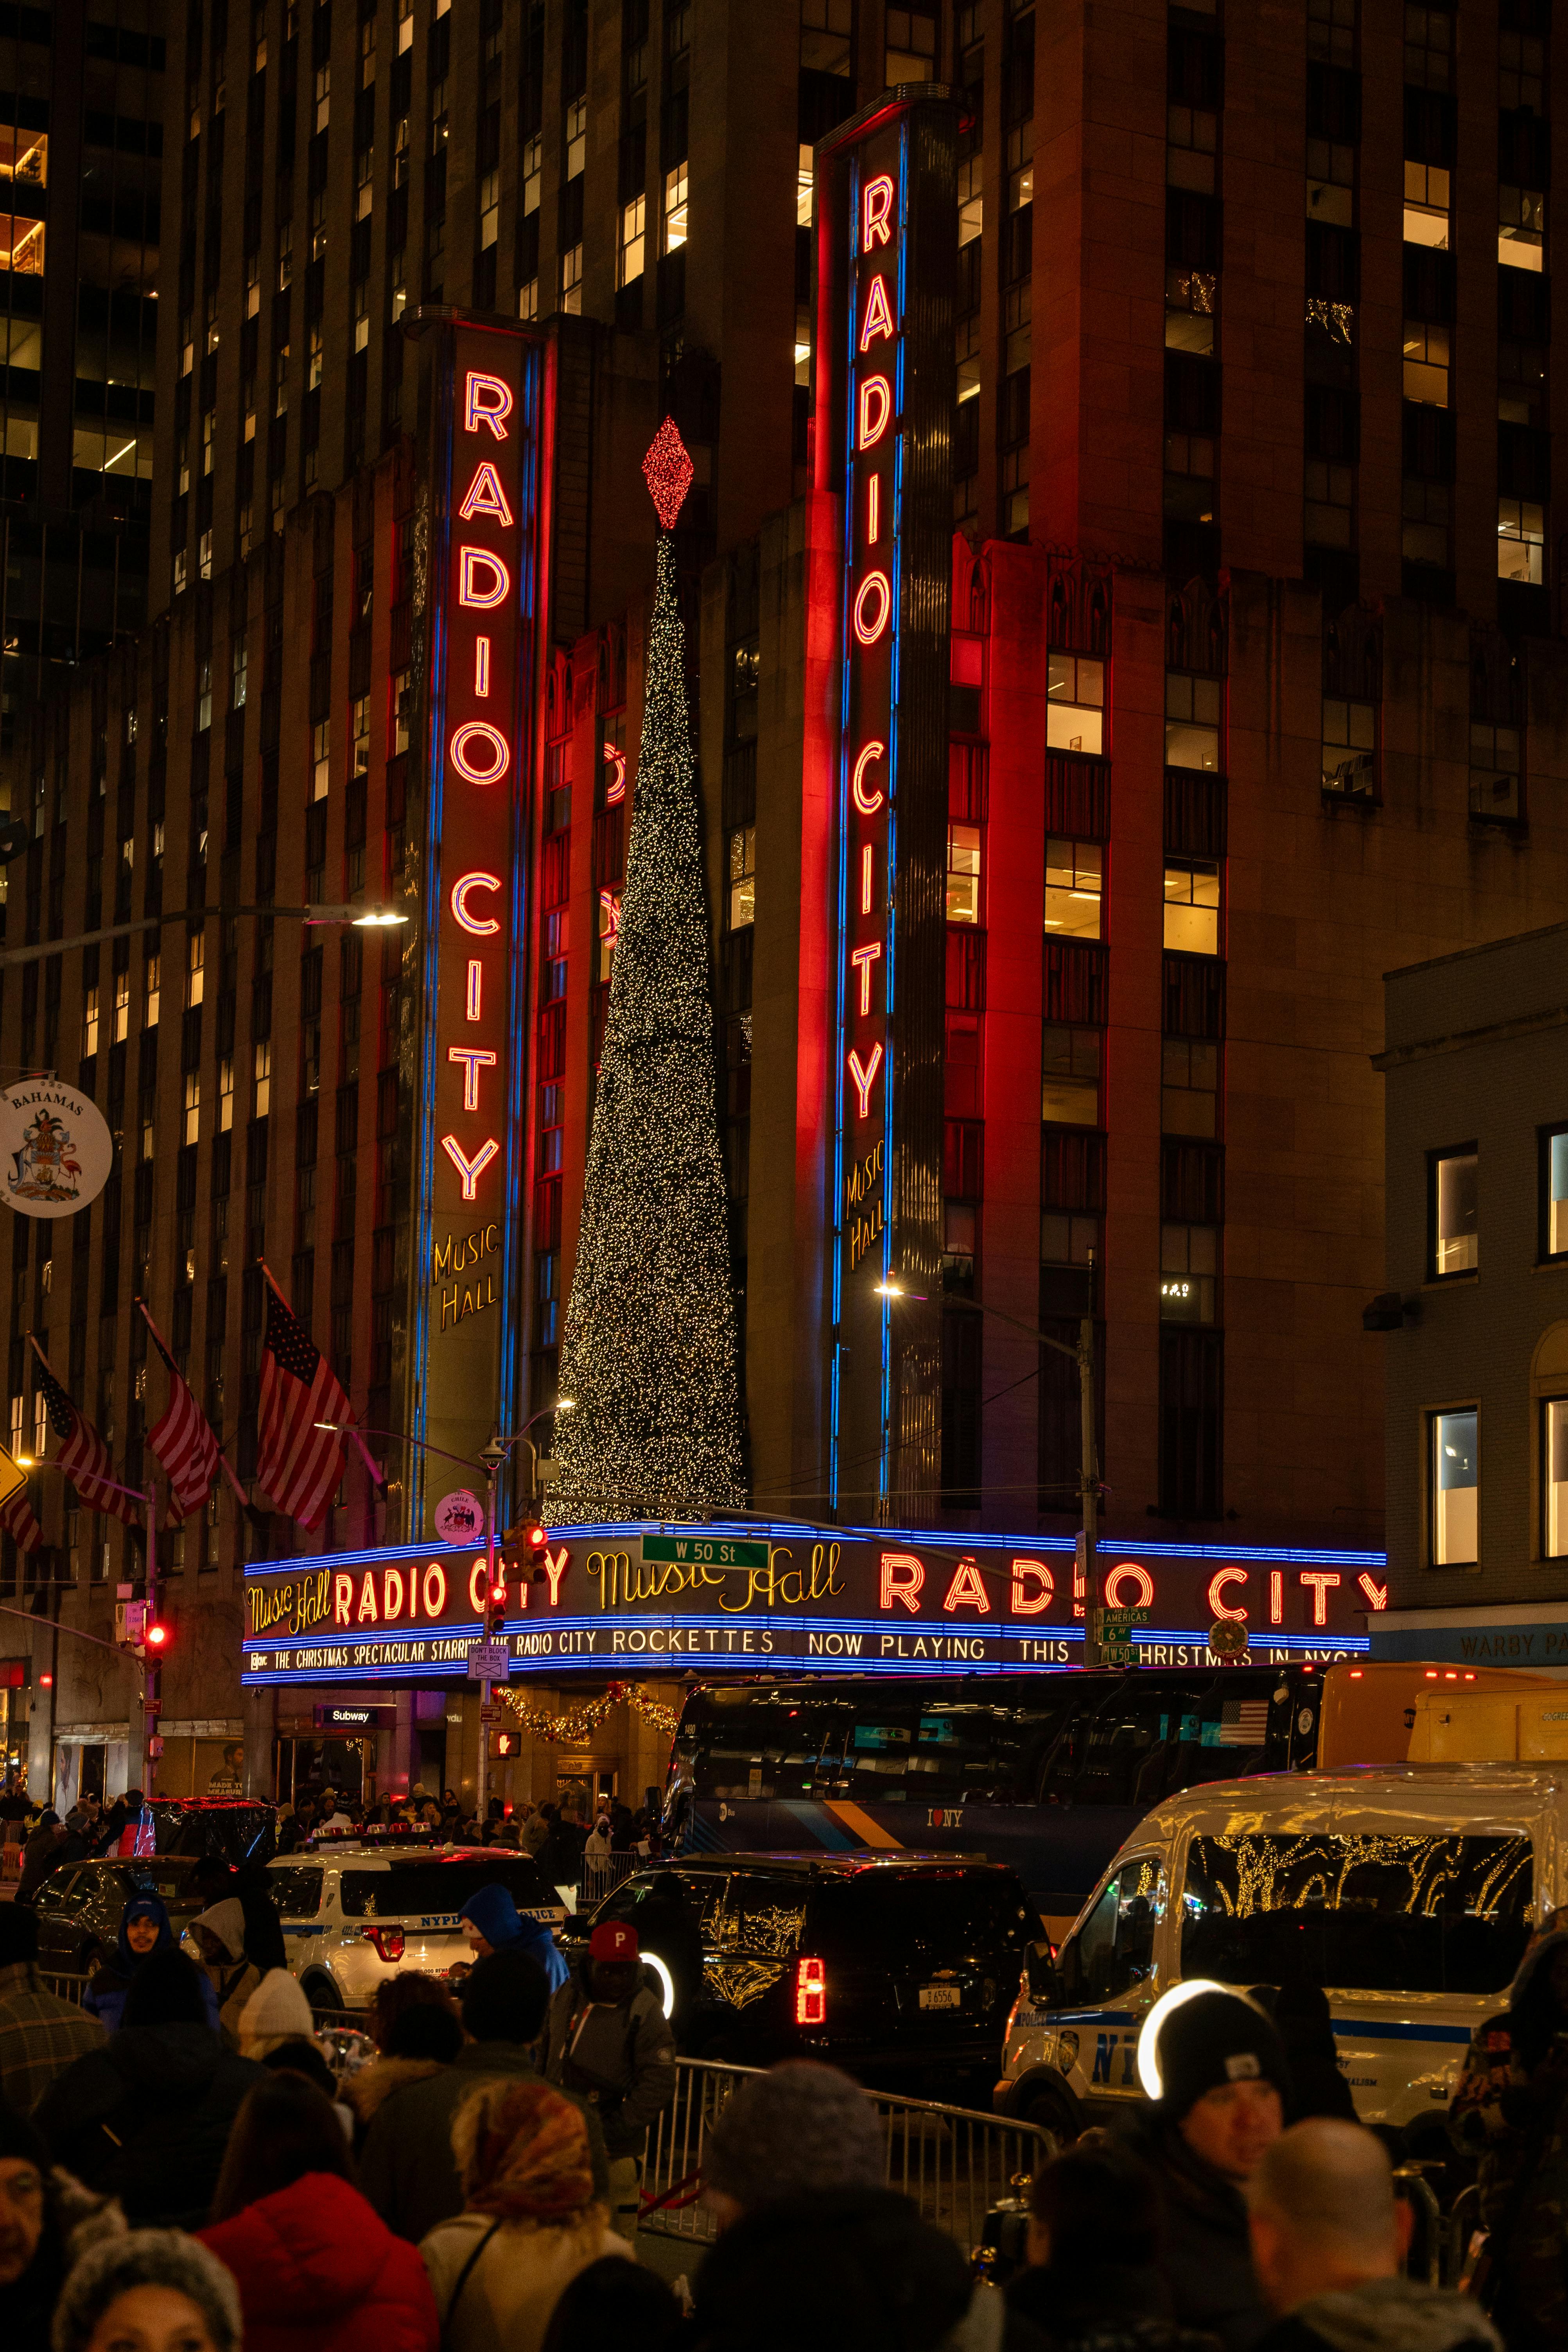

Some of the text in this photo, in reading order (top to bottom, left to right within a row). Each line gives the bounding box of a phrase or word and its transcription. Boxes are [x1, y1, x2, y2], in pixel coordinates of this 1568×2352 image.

[848, 174, 893, 1119] RADIO CITY
[441, 371, 513, 1200] RADIO CITY
[12, 1092, 83, 1116] BAHAMAS
[676, 1542, 736, 1562] W 50 St
[719, 1542, 846, 1612] Hall
[880, 1553, 1154, 1617] RADIO
[1208, 1567, 1387, 1625] CITY
[248, 1585, 292, 1633] Music
[288, 1568, 331, 1634] Hall
[335, 1562, 446, 1626] RADIO
[1106, 1612, 1148, 1623] AMERICAS
[1109, 1628, 1116, 1641] 6
[275, 1651, 290, 1669] THE
[296, 1647, 348, 1668] CHRISTMAS
[354, 1642, 425, 1665] SPECTACULAR
[431, 1638, 482, 1661] STARRI
[516, 1633, 552, 1656] RADIO
[559, 1631, 597, 1654] CITY
[613, 1629, 773, 1654] ROCKETTES
[809, 1633, 863, 1656] NOW
[881, 1635, 985, 1659] PLAYING
[1019, 1639, 1069, 1662] THIS
[1111, 1647, 1117, 1661] W
[1119, 1647, 1130, 1661] 50
[1213, 1645, 1246, 1658] HAPPY HOLIDAYS
[1460, 1634, 1534, 1658] WARBY
[333, 1710, 369, 1723] Subway
[685, 1724, 696, 1735] 1490
[927, 1808, 963, 1827] I NY
[420, 1909, 555, 1927] NYPD OLICE
[615, 1932, 626, 1948] P
[934, 1990, 953, 2003] 6556
